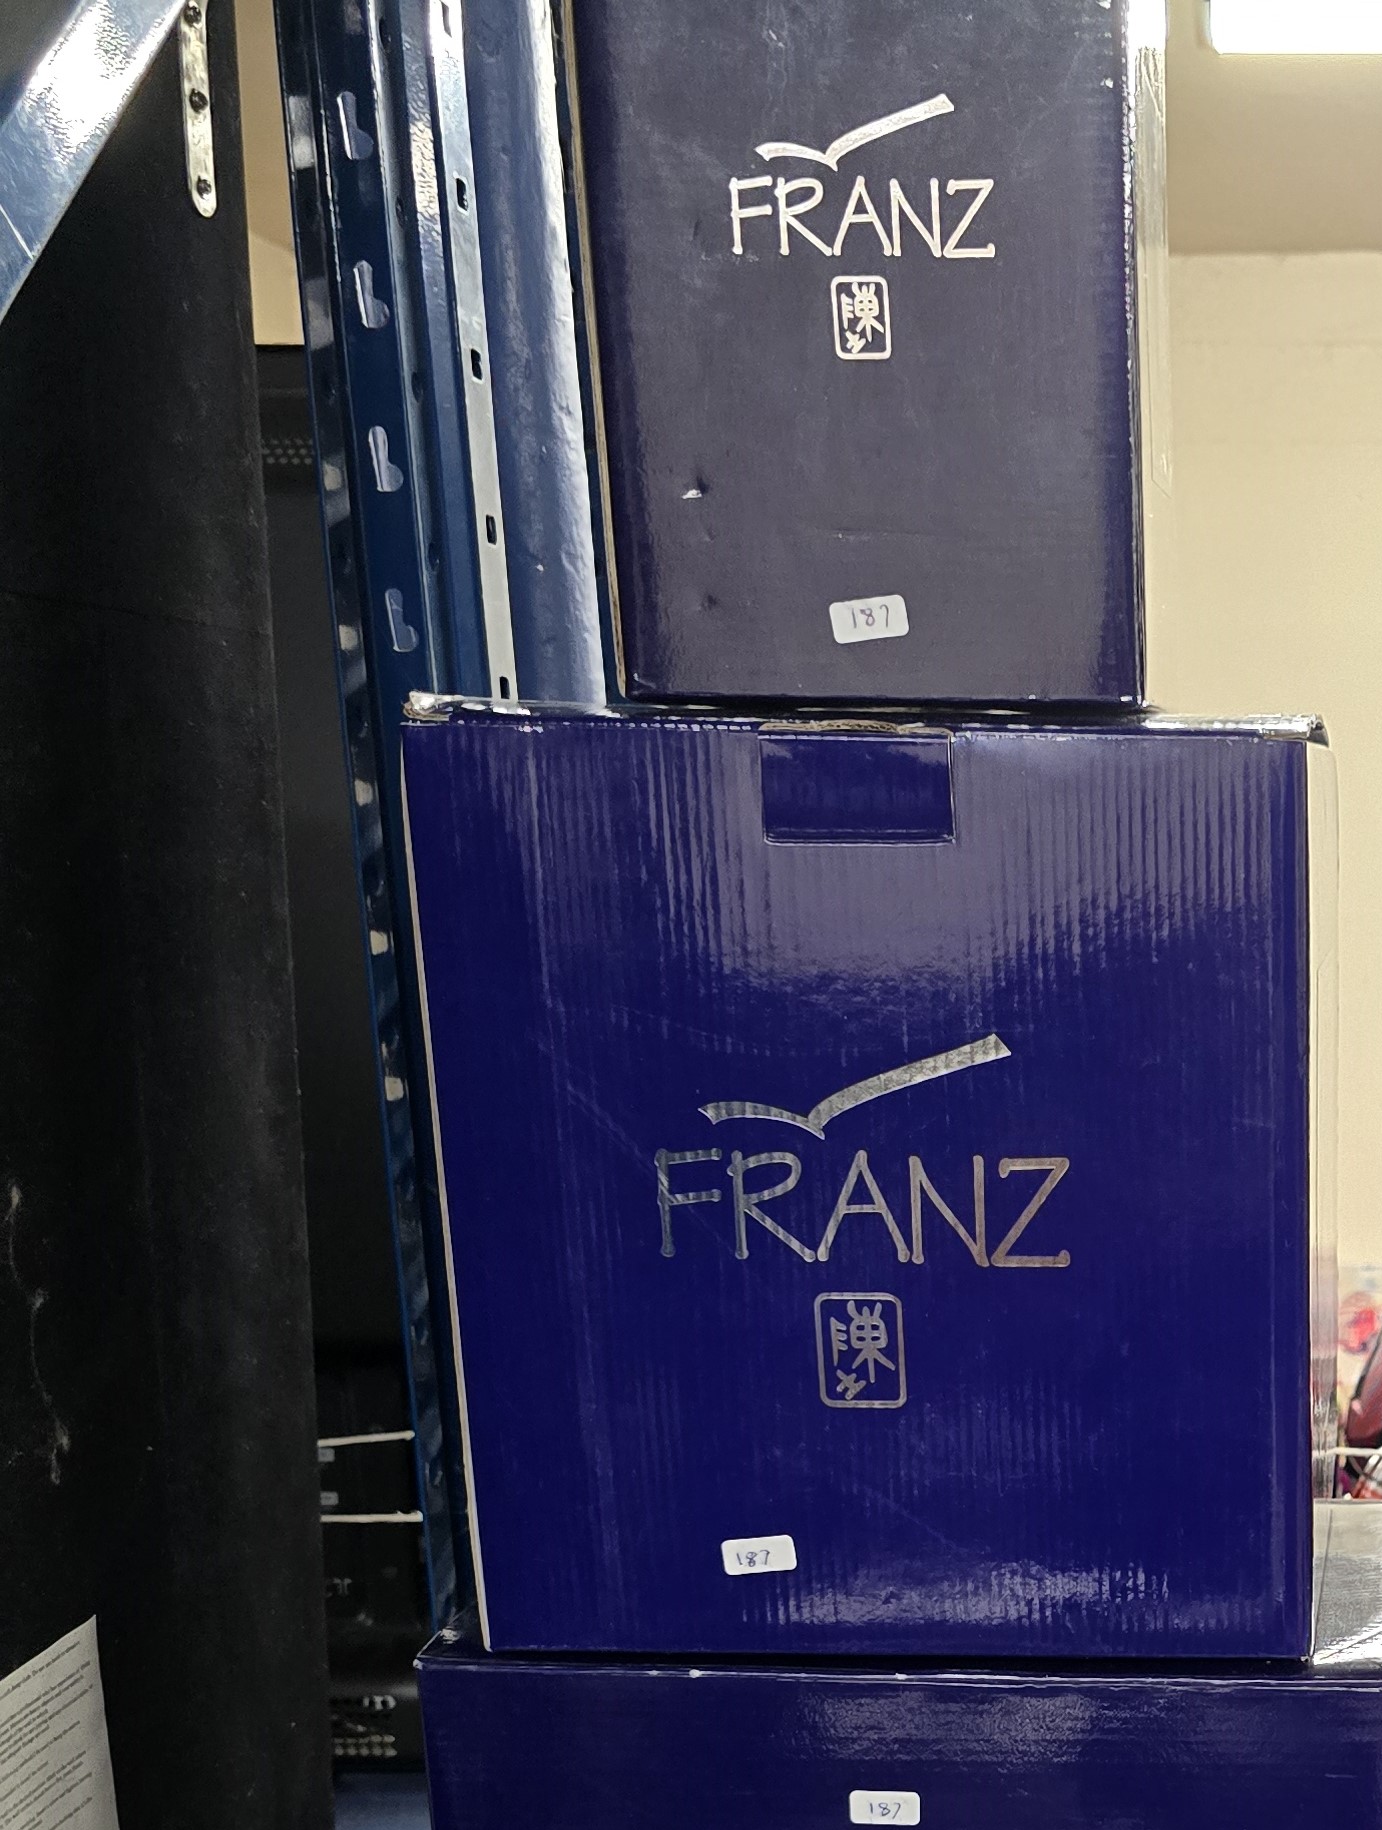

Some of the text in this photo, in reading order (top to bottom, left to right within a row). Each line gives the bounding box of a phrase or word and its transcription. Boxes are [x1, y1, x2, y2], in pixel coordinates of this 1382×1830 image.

[728, 175, 996, 259] FRANZ
[849, 603, 891, 630] 187
[655, 1149, 1071, 1267] FRANZ
[735, 1549, 770, 1569] 187
[867, 1800, 902, 1820] 187
